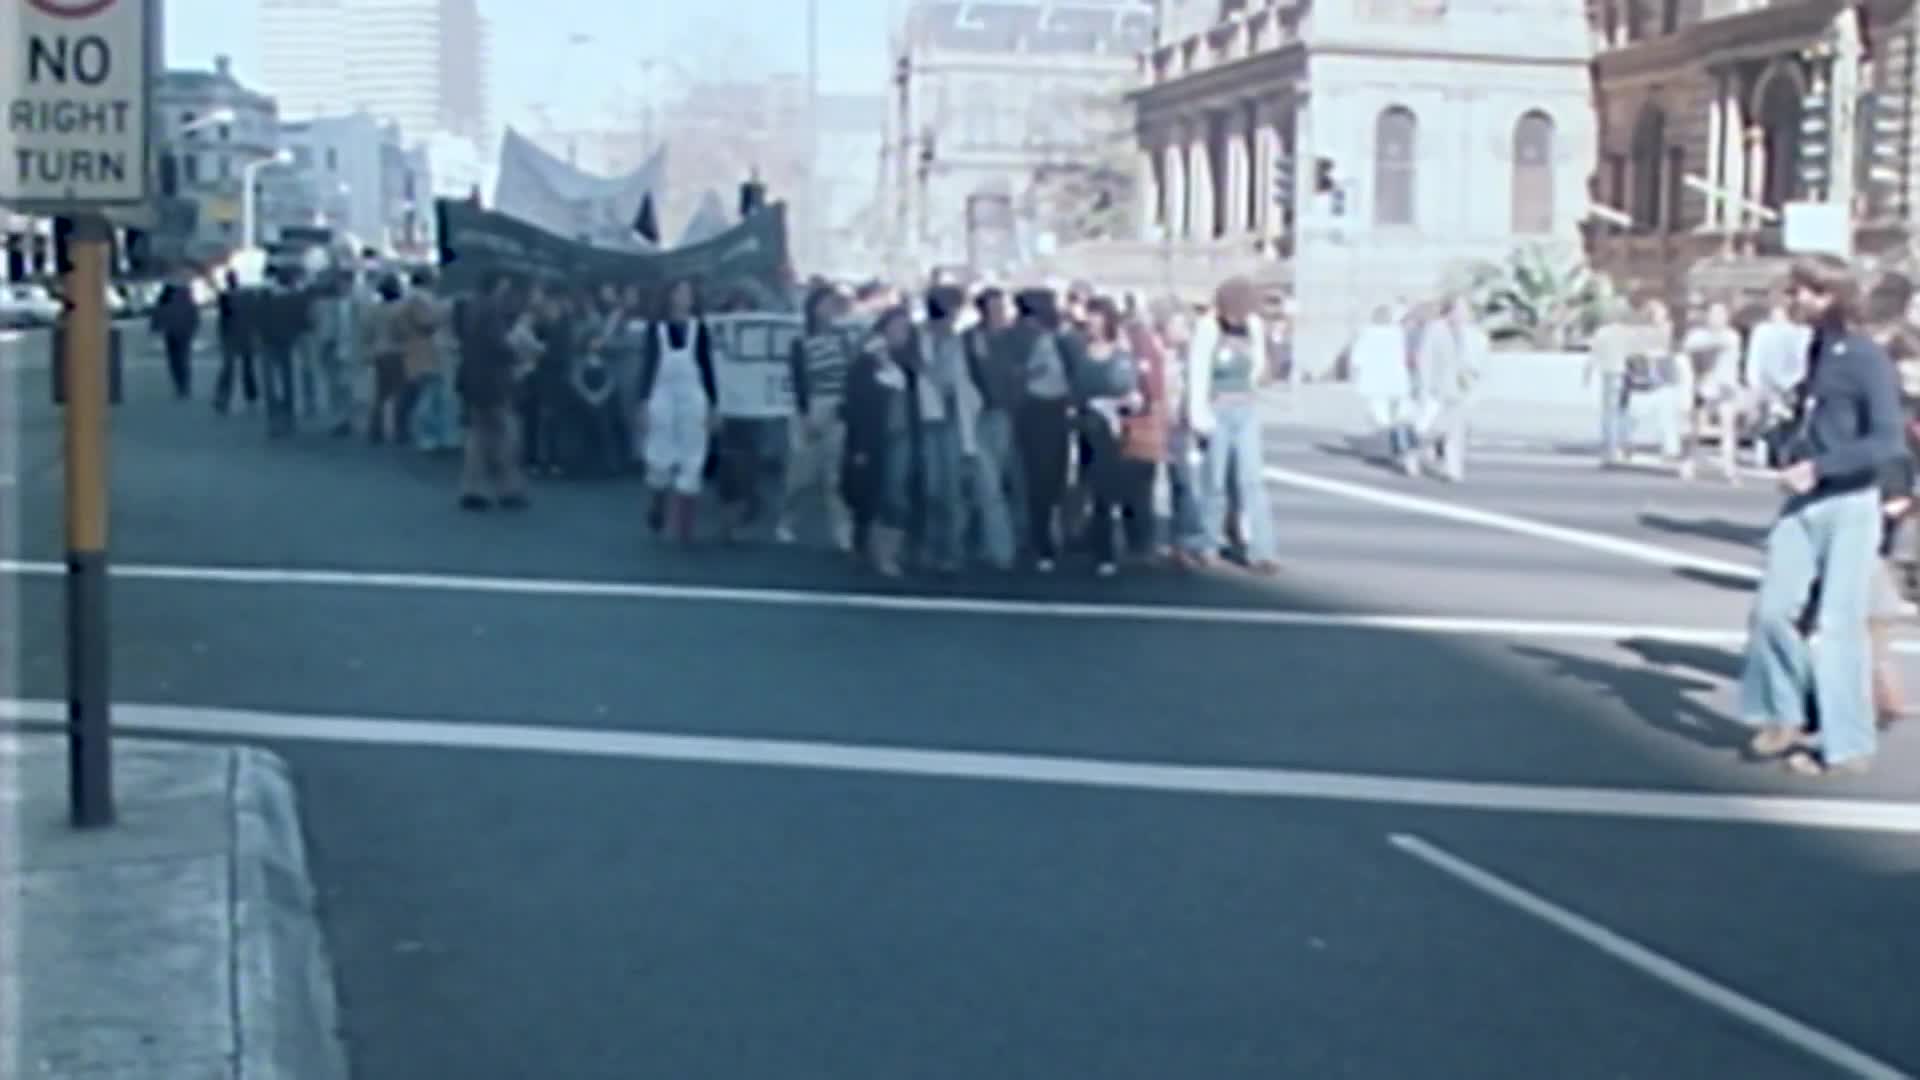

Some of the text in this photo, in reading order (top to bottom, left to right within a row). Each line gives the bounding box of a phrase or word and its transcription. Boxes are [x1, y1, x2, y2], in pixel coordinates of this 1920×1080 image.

[28, 35, 111, 85] NO
[9, 99, 129, 133] RIGHT
[15, 148, 126, 182] TURN
